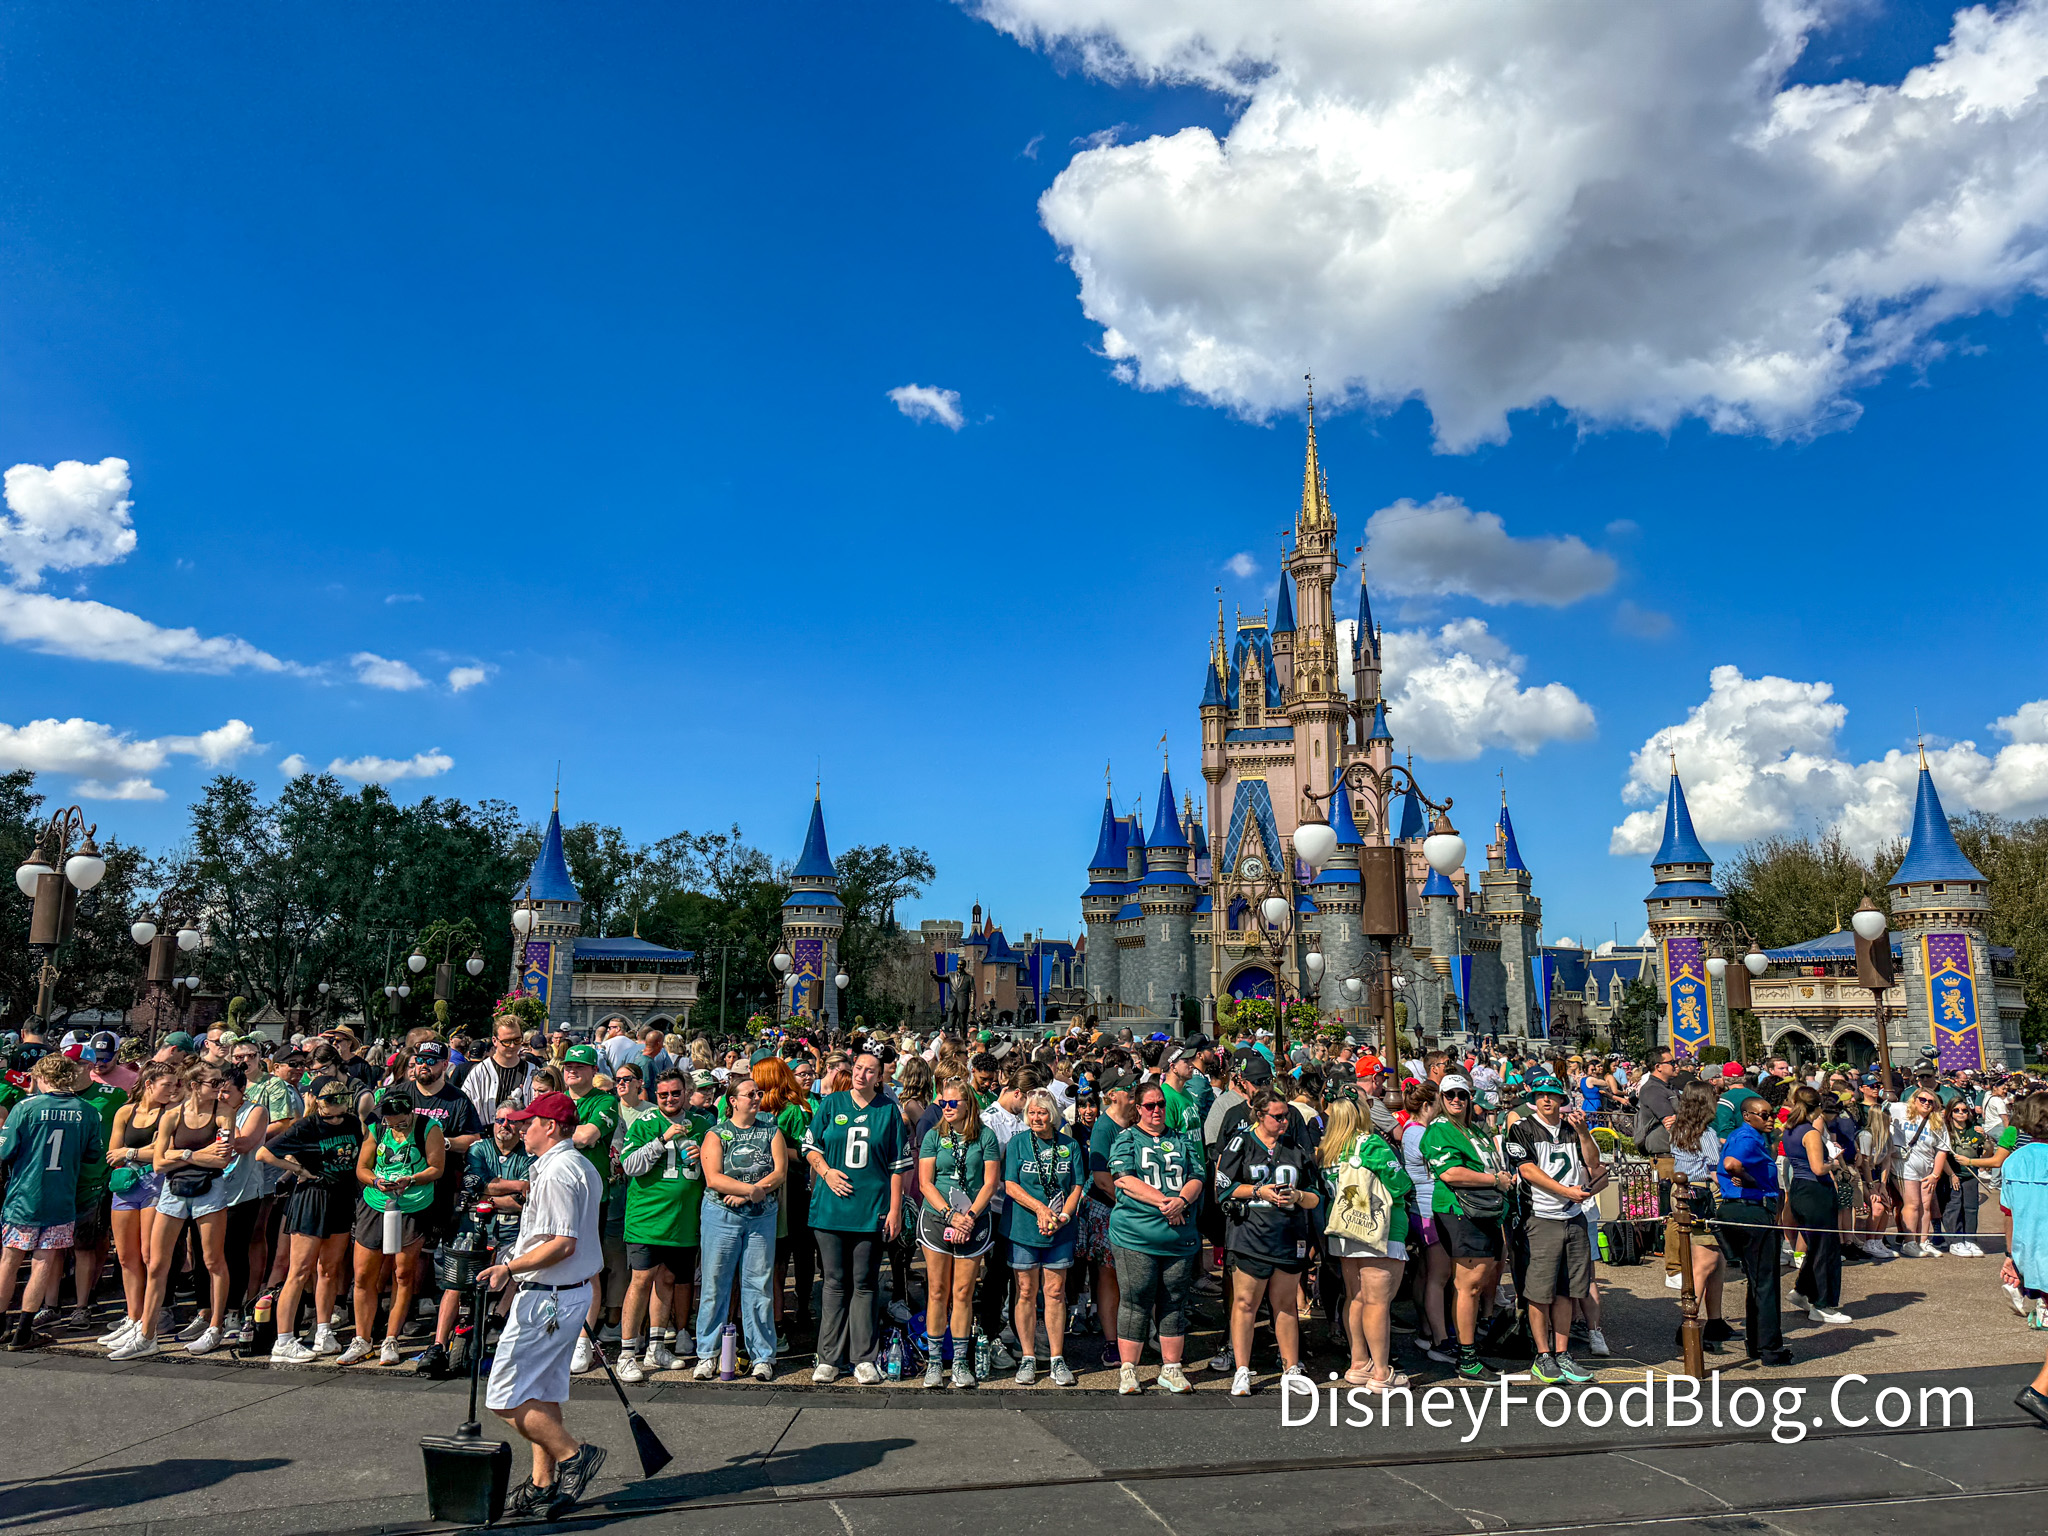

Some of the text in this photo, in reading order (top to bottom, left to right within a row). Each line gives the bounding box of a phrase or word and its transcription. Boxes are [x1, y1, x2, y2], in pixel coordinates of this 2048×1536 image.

[41, 1109, 82, 1122] HURTS
[45, 1128, 64, 1171] 1
[845, 1126, 869, 1169] 6
[1141, 1147, 1183, 1192] 55
